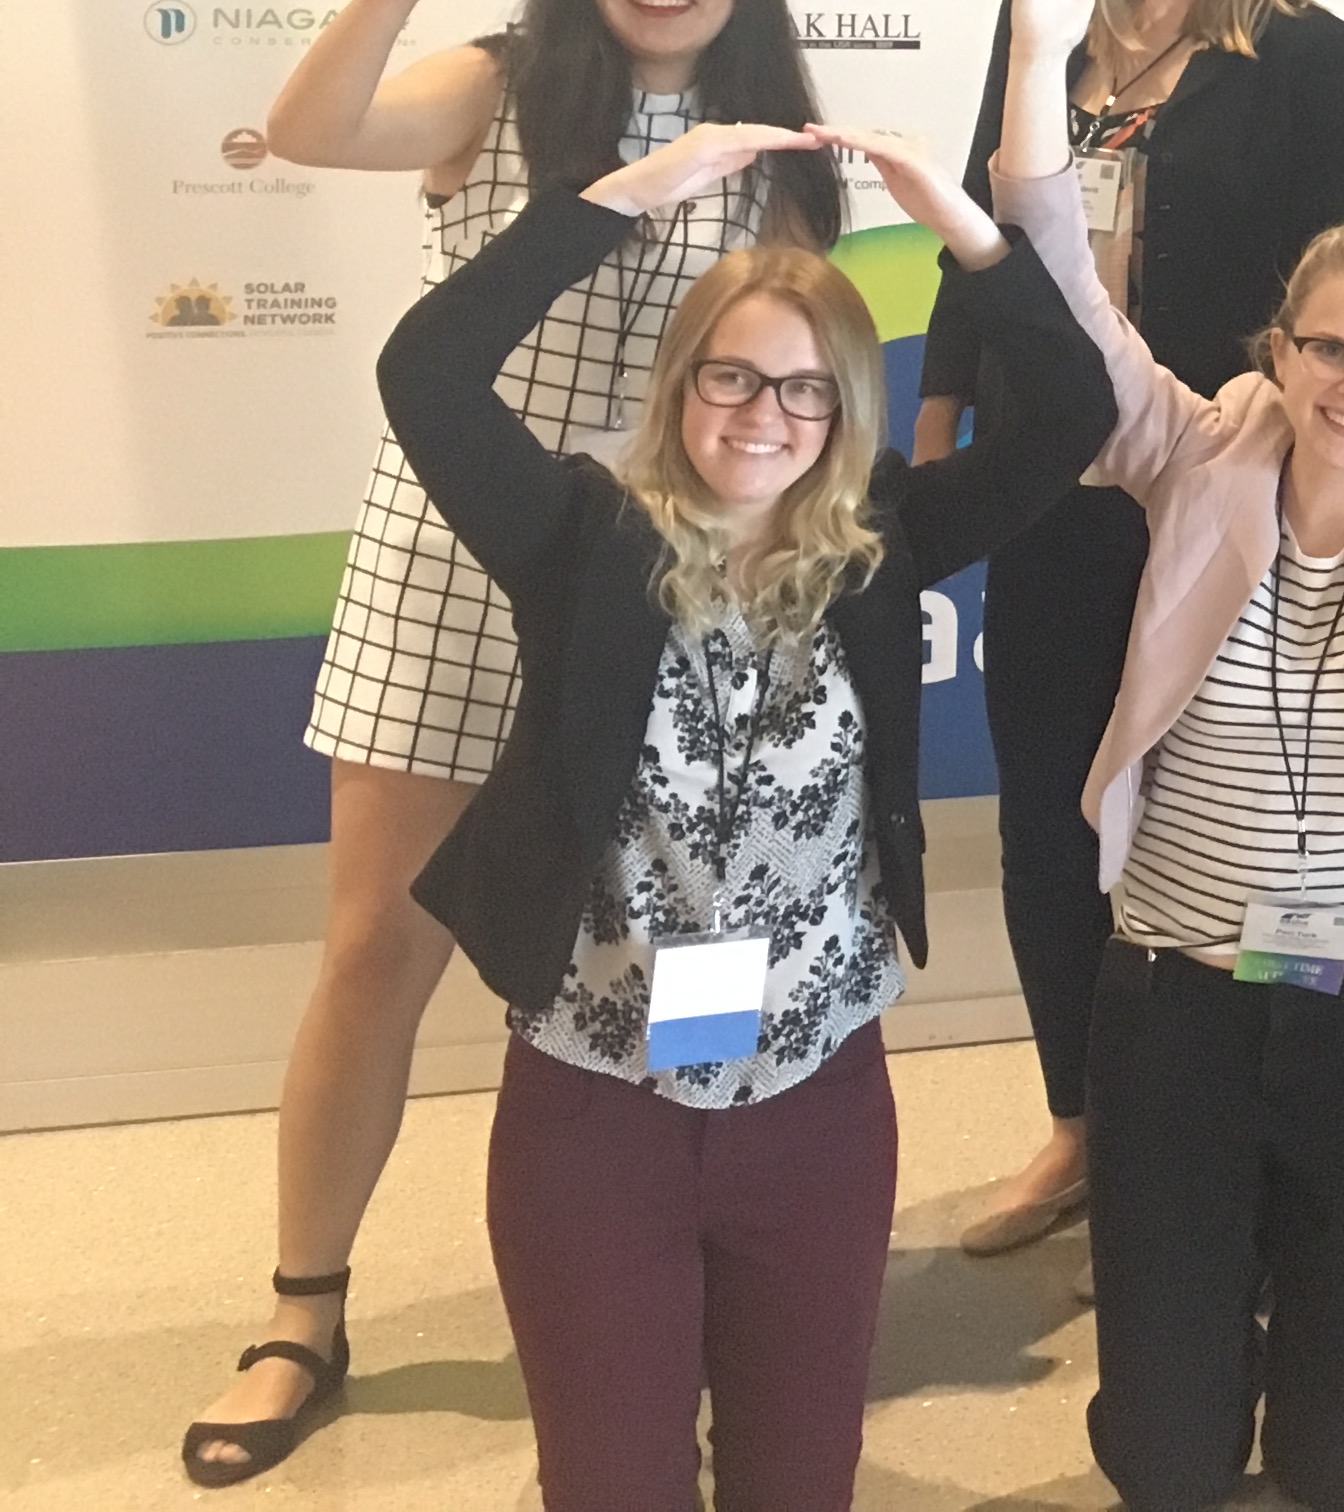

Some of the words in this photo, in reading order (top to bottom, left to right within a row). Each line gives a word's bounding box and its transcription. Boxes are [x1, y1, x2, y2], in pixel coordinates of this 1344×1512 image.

[835, 12, 921, 39] HALL
[172, 179, 243, 194] Prescott
[249, 177, 316, 199] College
[244, 282, 306, 295] SOLAR
[244, 296, 337, 310] TRAINING
[243, 312, 336, 326] NETWORK
